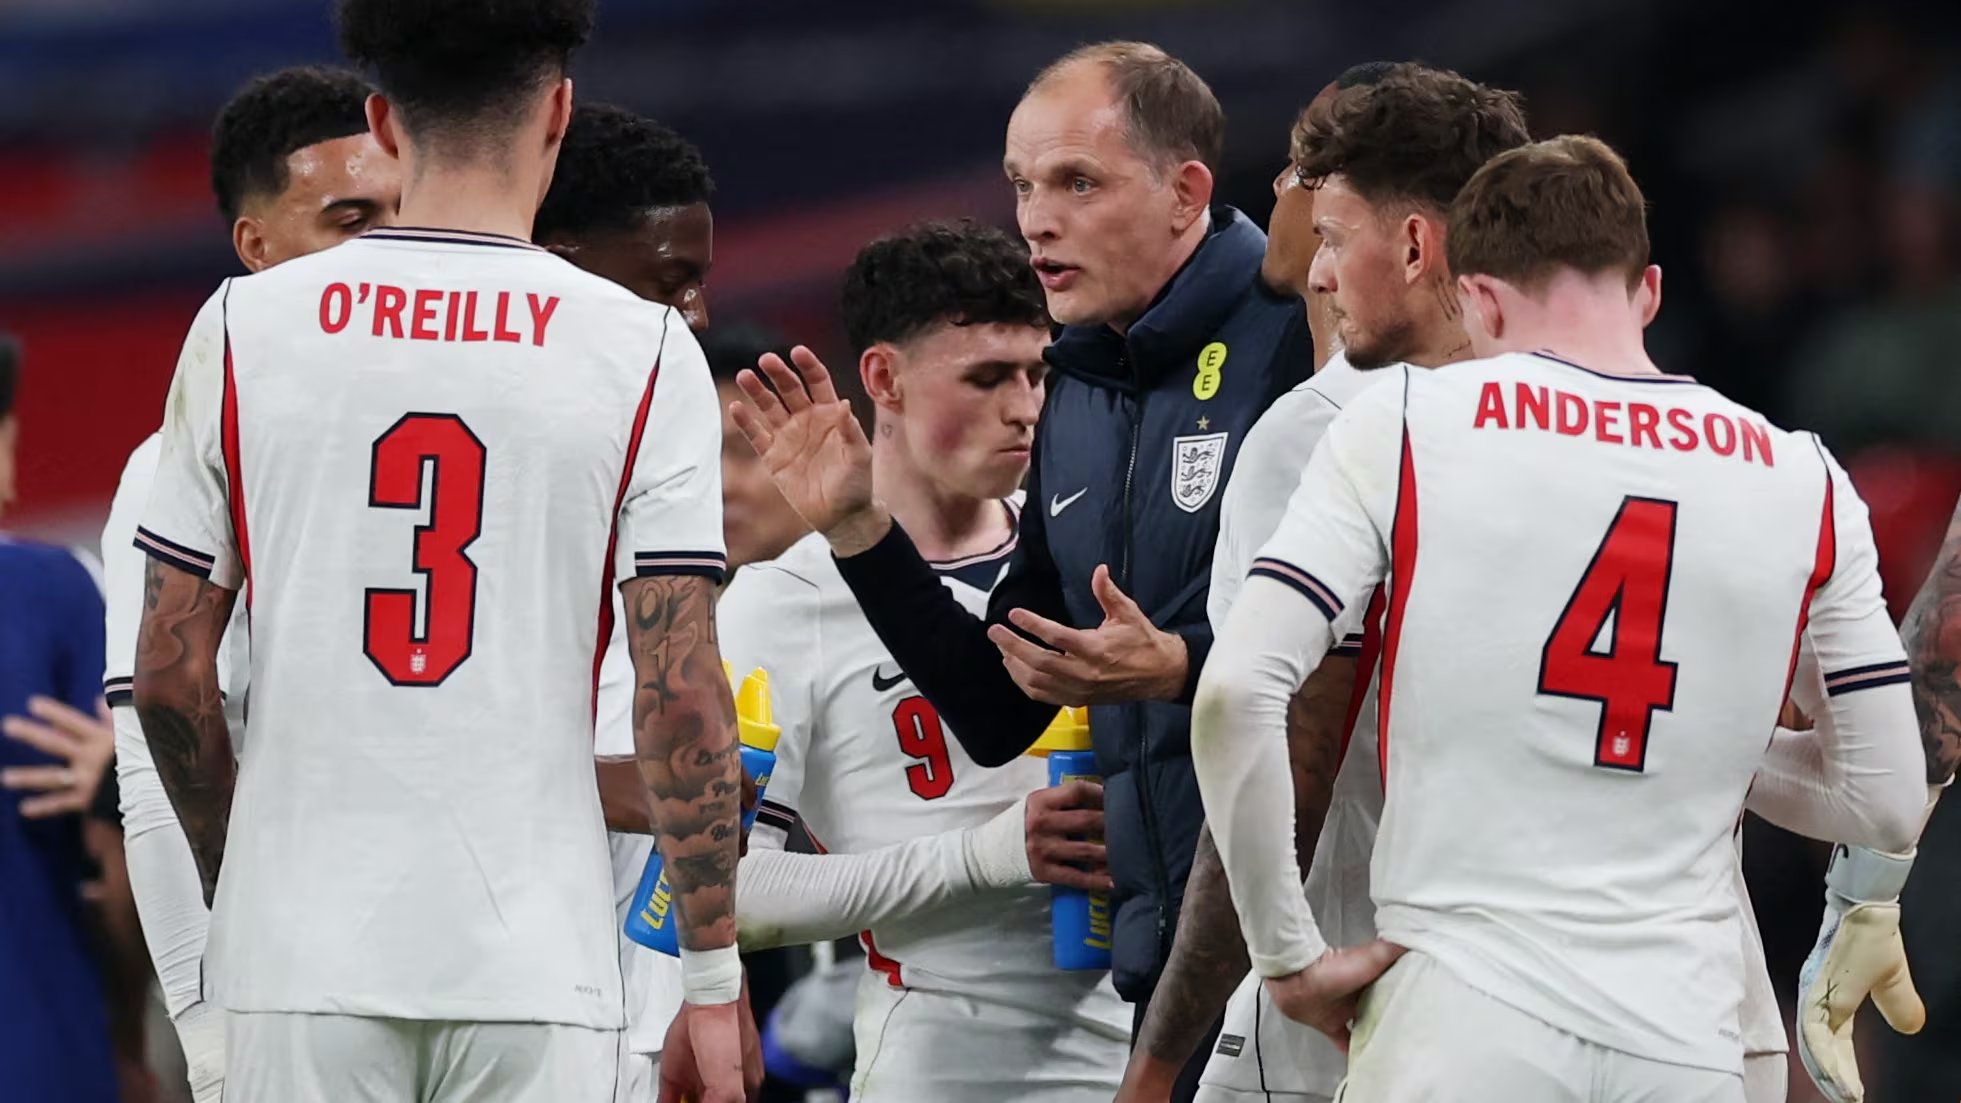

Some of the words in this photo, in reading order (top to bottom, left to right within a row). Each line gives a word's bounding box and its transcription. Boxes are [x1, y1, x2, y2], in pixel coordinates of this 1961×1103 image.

[319, 282, 560, 347] O'REILLY
[1473, 382, 1775, 467] ANDERSON
[363, 411, 487, 688] 3
[1537, 495, 1679, 773] 4
[892, 695, 955, 801] 9
